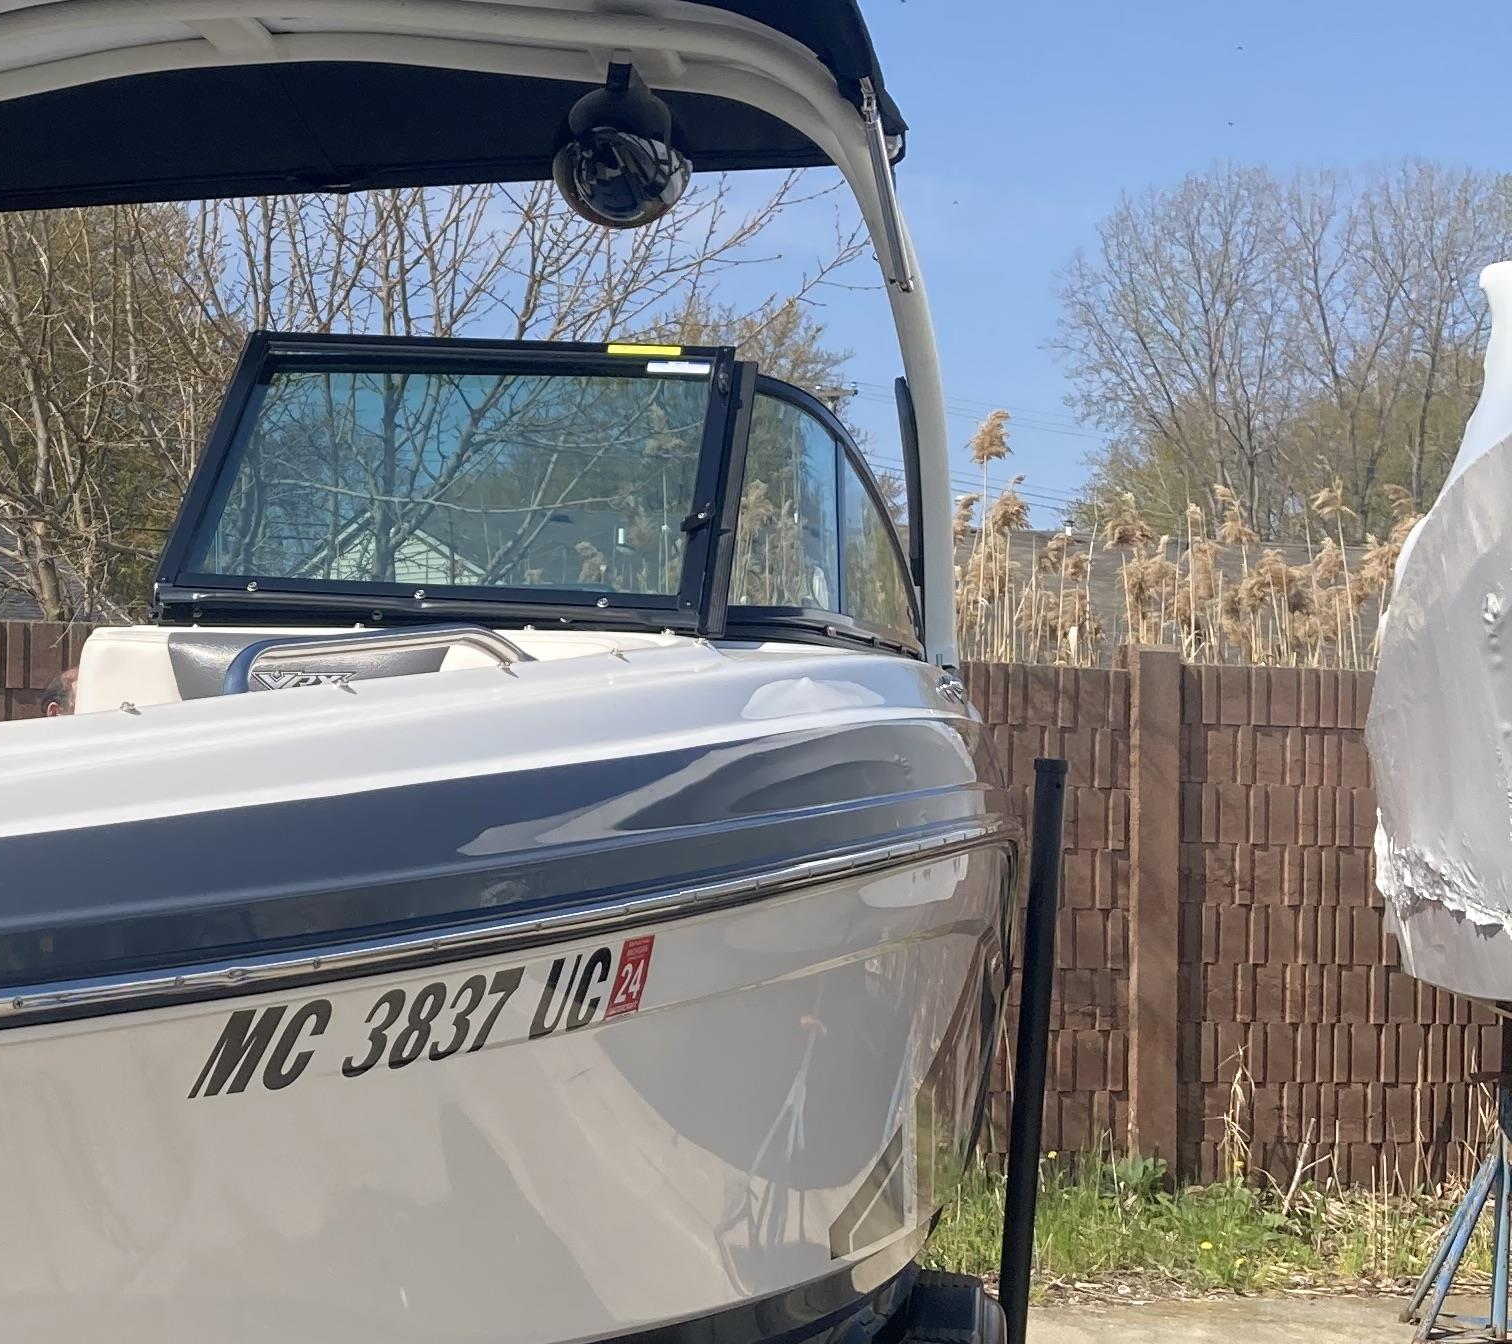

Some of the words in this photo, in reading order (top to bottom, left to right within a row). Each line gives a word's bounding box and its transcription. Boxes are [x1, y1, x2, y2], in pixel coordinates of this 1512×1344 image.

[188, 999, 332, 1098] MC
[342, 966, 525, 1077] 3837
[528, 947, 612, 1041] UC
[614, 959, 645, 1004] 24
